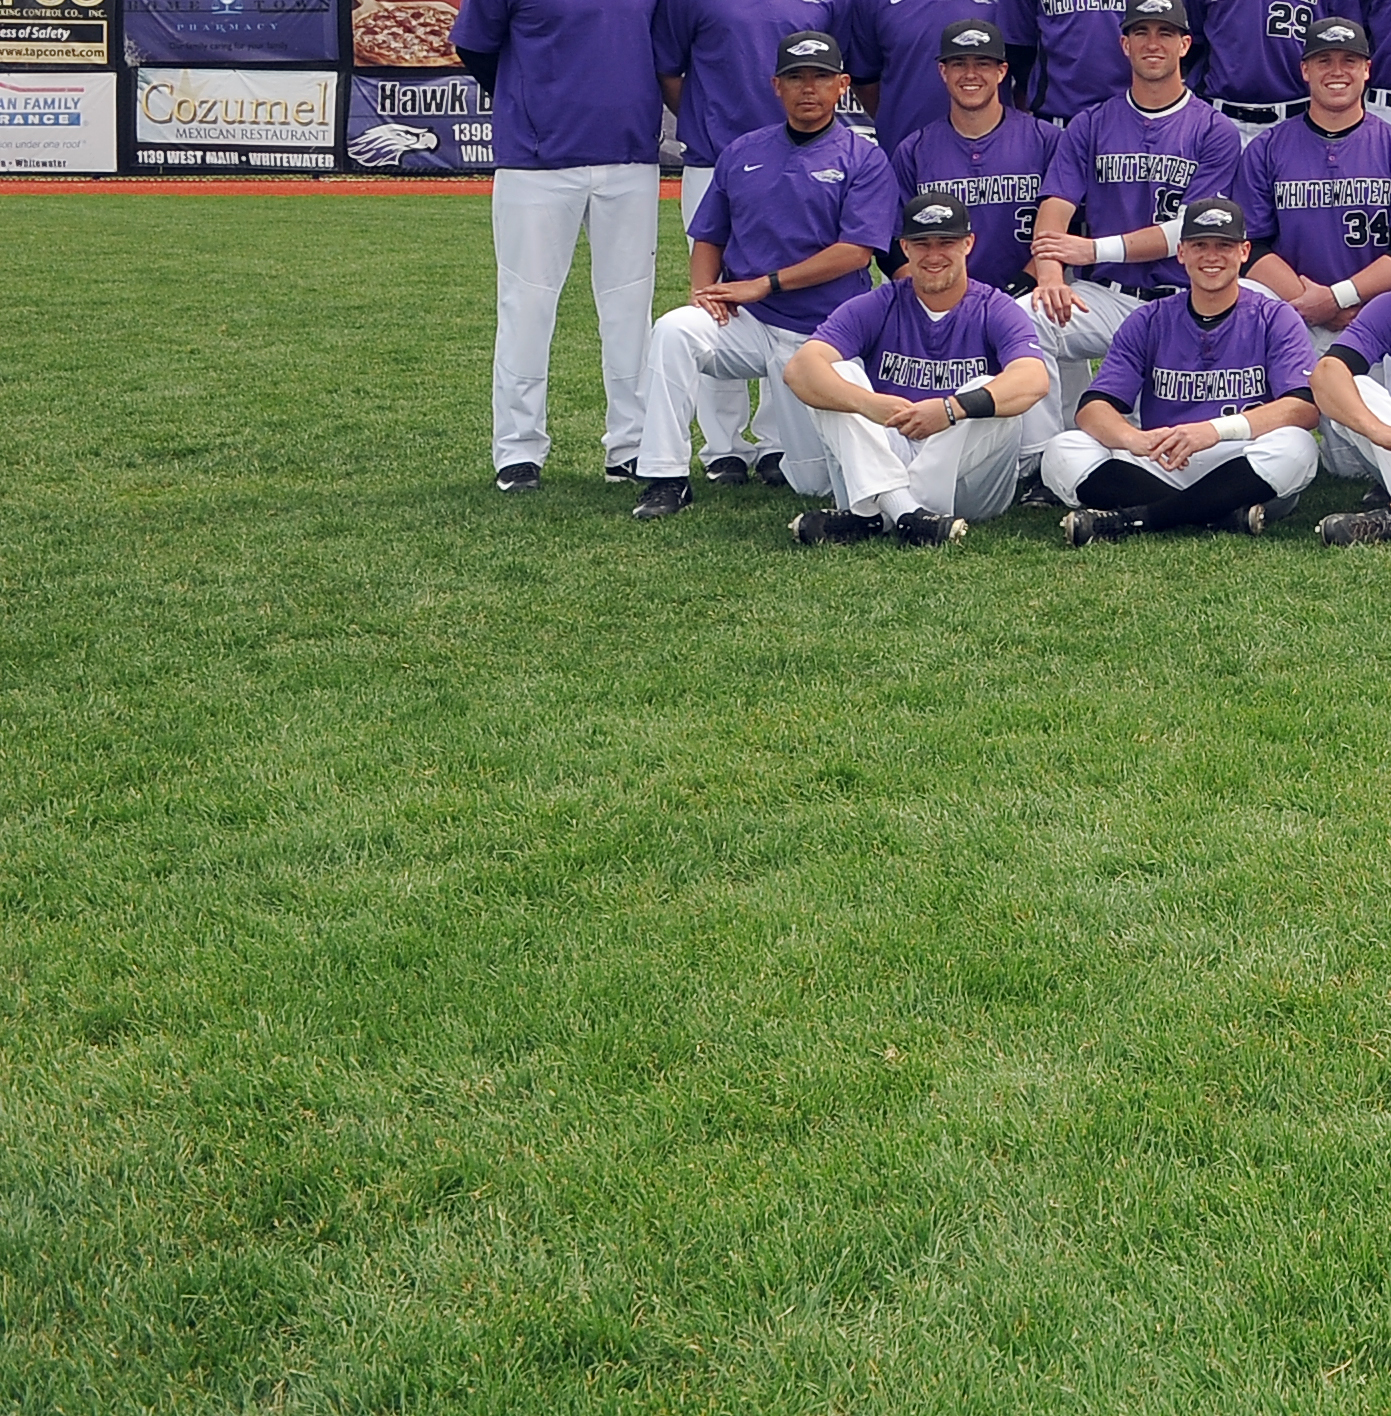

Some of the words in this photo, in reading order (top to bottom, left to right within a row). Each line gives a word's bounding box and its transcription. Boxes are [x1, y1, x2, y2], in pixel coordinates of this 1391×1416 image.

[23, 8, 62, 17] CONTROL
[128, 0, 200, 11] HOME
[177, 23, 279, 32] PHARMACY
[1266, 1, 1314, 45] 29
[18, 26, 32, 38] of
[32, 26, 70, 41] Safety
[24, 98, 81, 110] FAMILY
[141, 81, 329, 125] Cozumel
[378, 80, 468, 115] Hawk
[175, 127, 236, 140] MEXICAN
[241, 128, 329, 141] RESTAURANT
[452, 123, 493, 141] 1398
[15, 159, 67, 168] Whitewater
[137, 150, 164, 164] 1139
[166, 150, 203, 164] WEST
[206, 151, 239, 164] MAIN
[249, 152, 334, 168] WHITEWATER
[1274, 177, 1391, 209] WHITEWATER
[1342, 209, 1390, 248] 34
[878, 350, 989, 390] WHITEWATER
